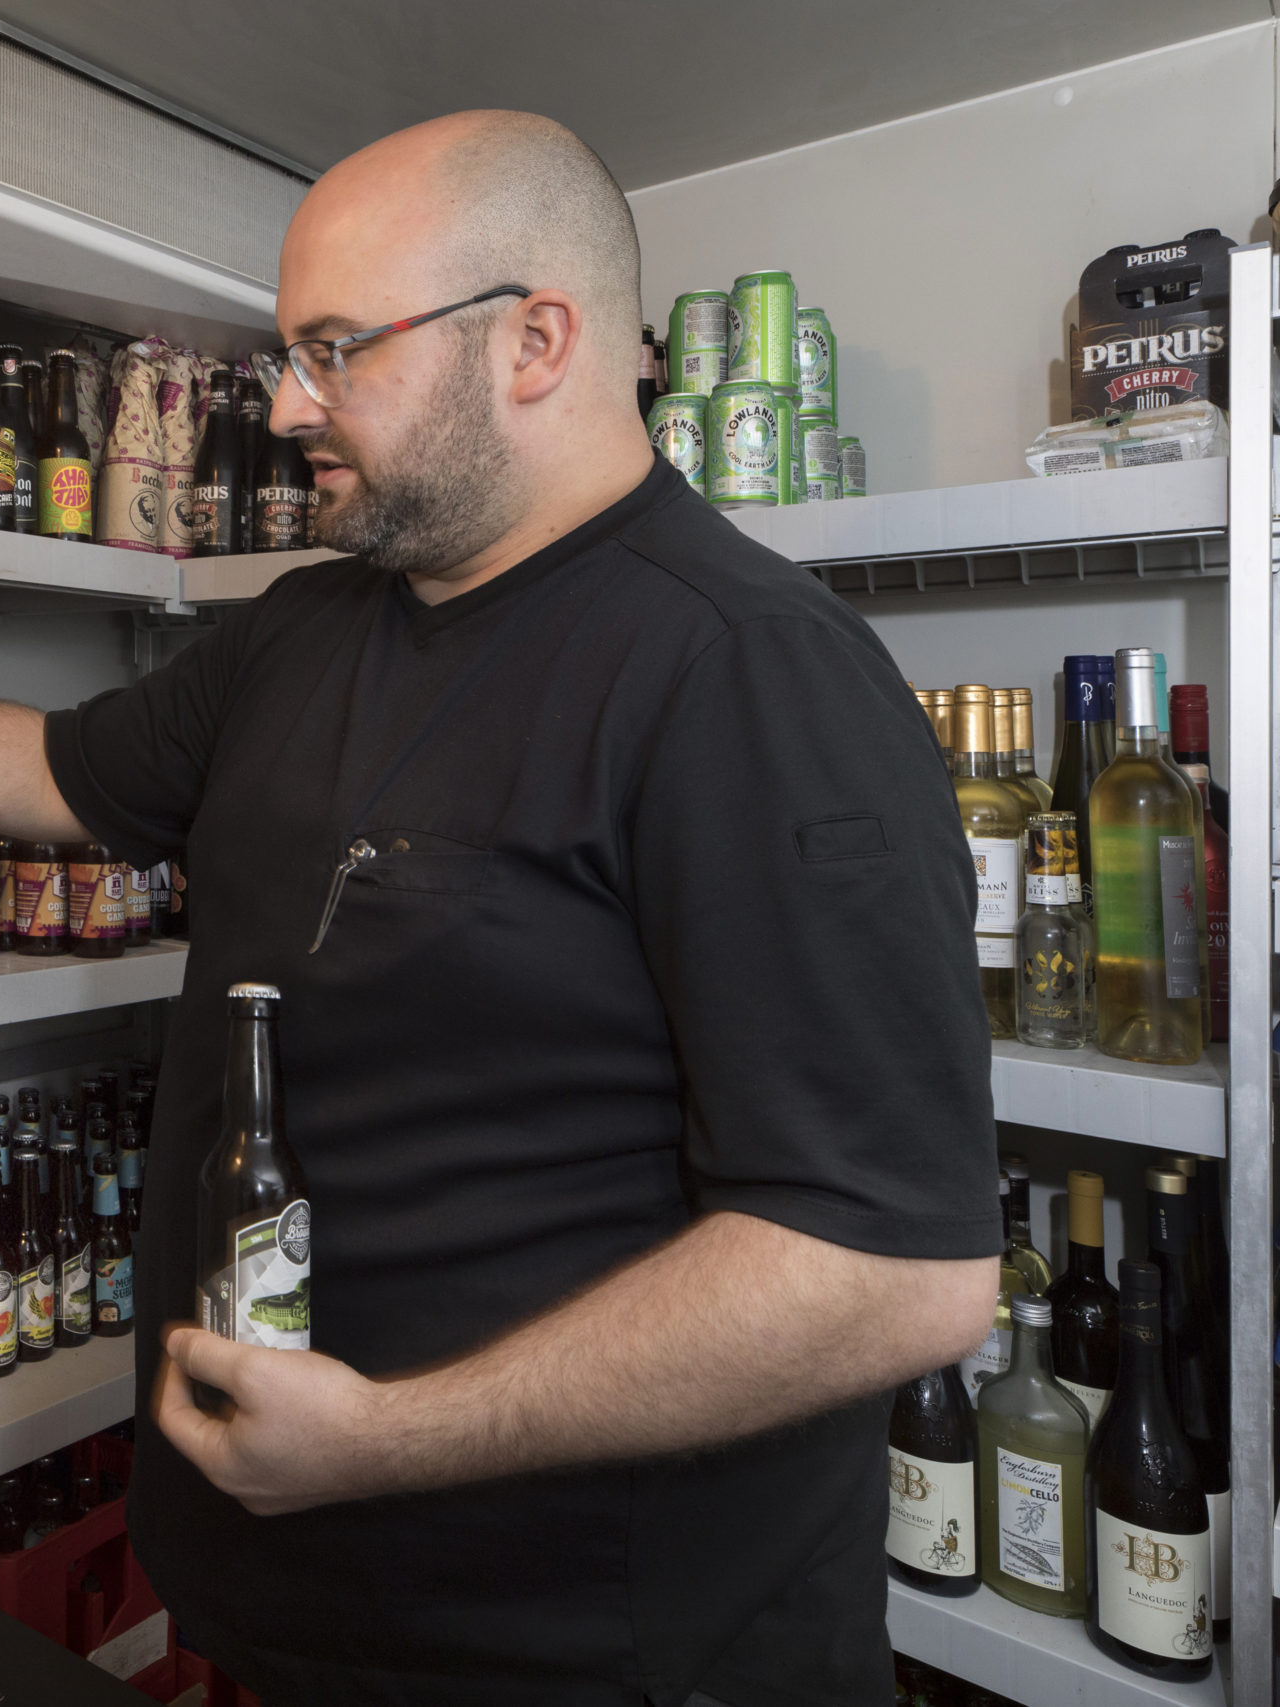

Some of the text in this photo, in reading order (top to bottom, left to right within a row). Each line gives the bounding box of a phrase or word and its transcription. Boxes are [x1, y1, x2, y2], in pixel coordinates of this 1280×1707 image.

[1126, 245, 1188, 268] PETRUS
[1082, 324, 1225, 373] PETRUS
[1122, 368, 1180, 391] CHERRY
[168, 474, 194, 490] Bacc
[257, 488, 306, 504] PETRUS
[1000, 1478, 1060, 1502] LIMONCELLO
[890, 1506, 936, 1526] ANGUEDOC
[1128, 1586, 1188, 1608] LANGUEDOC
